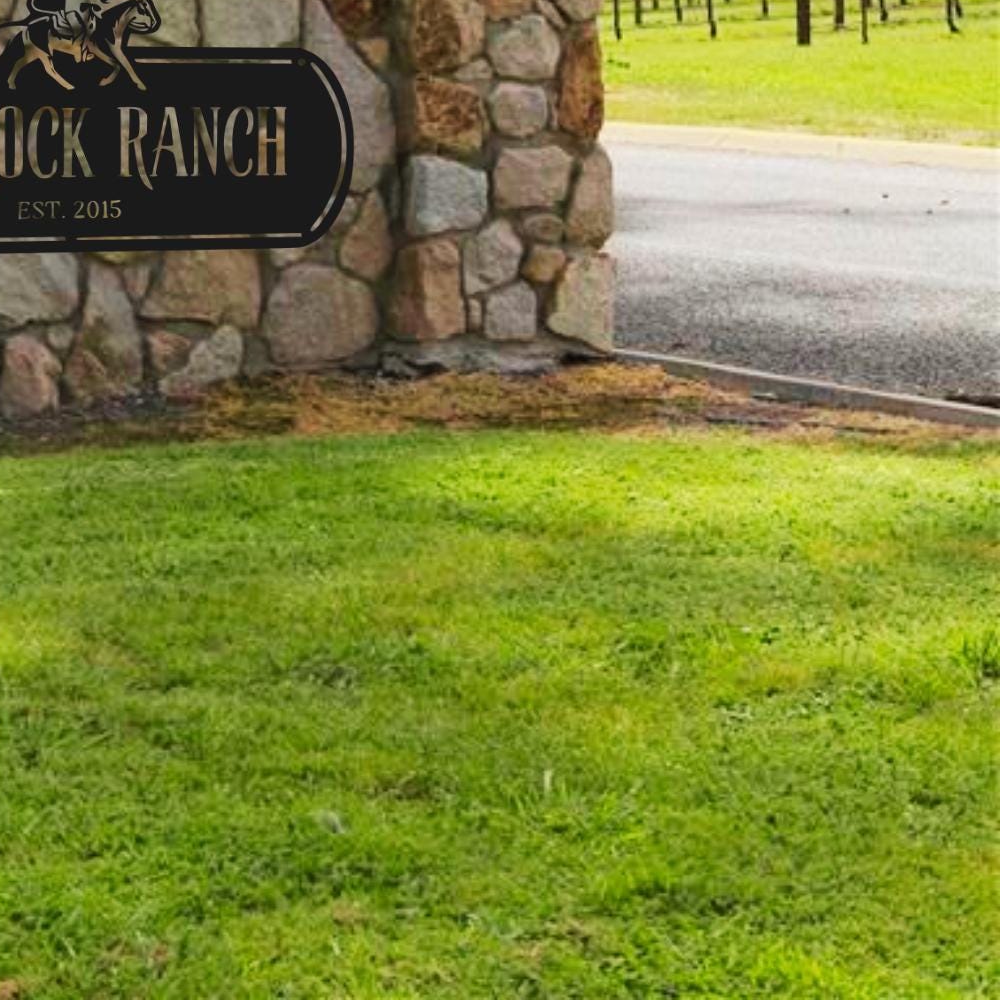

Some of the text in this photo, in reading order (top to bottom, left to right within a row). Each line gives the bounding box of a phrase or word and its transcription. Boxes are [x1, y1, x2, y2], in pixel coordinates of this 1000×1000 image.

[117, 105, 288, 191] RANCH
[17, 199, 122, 220] EST. 2015
